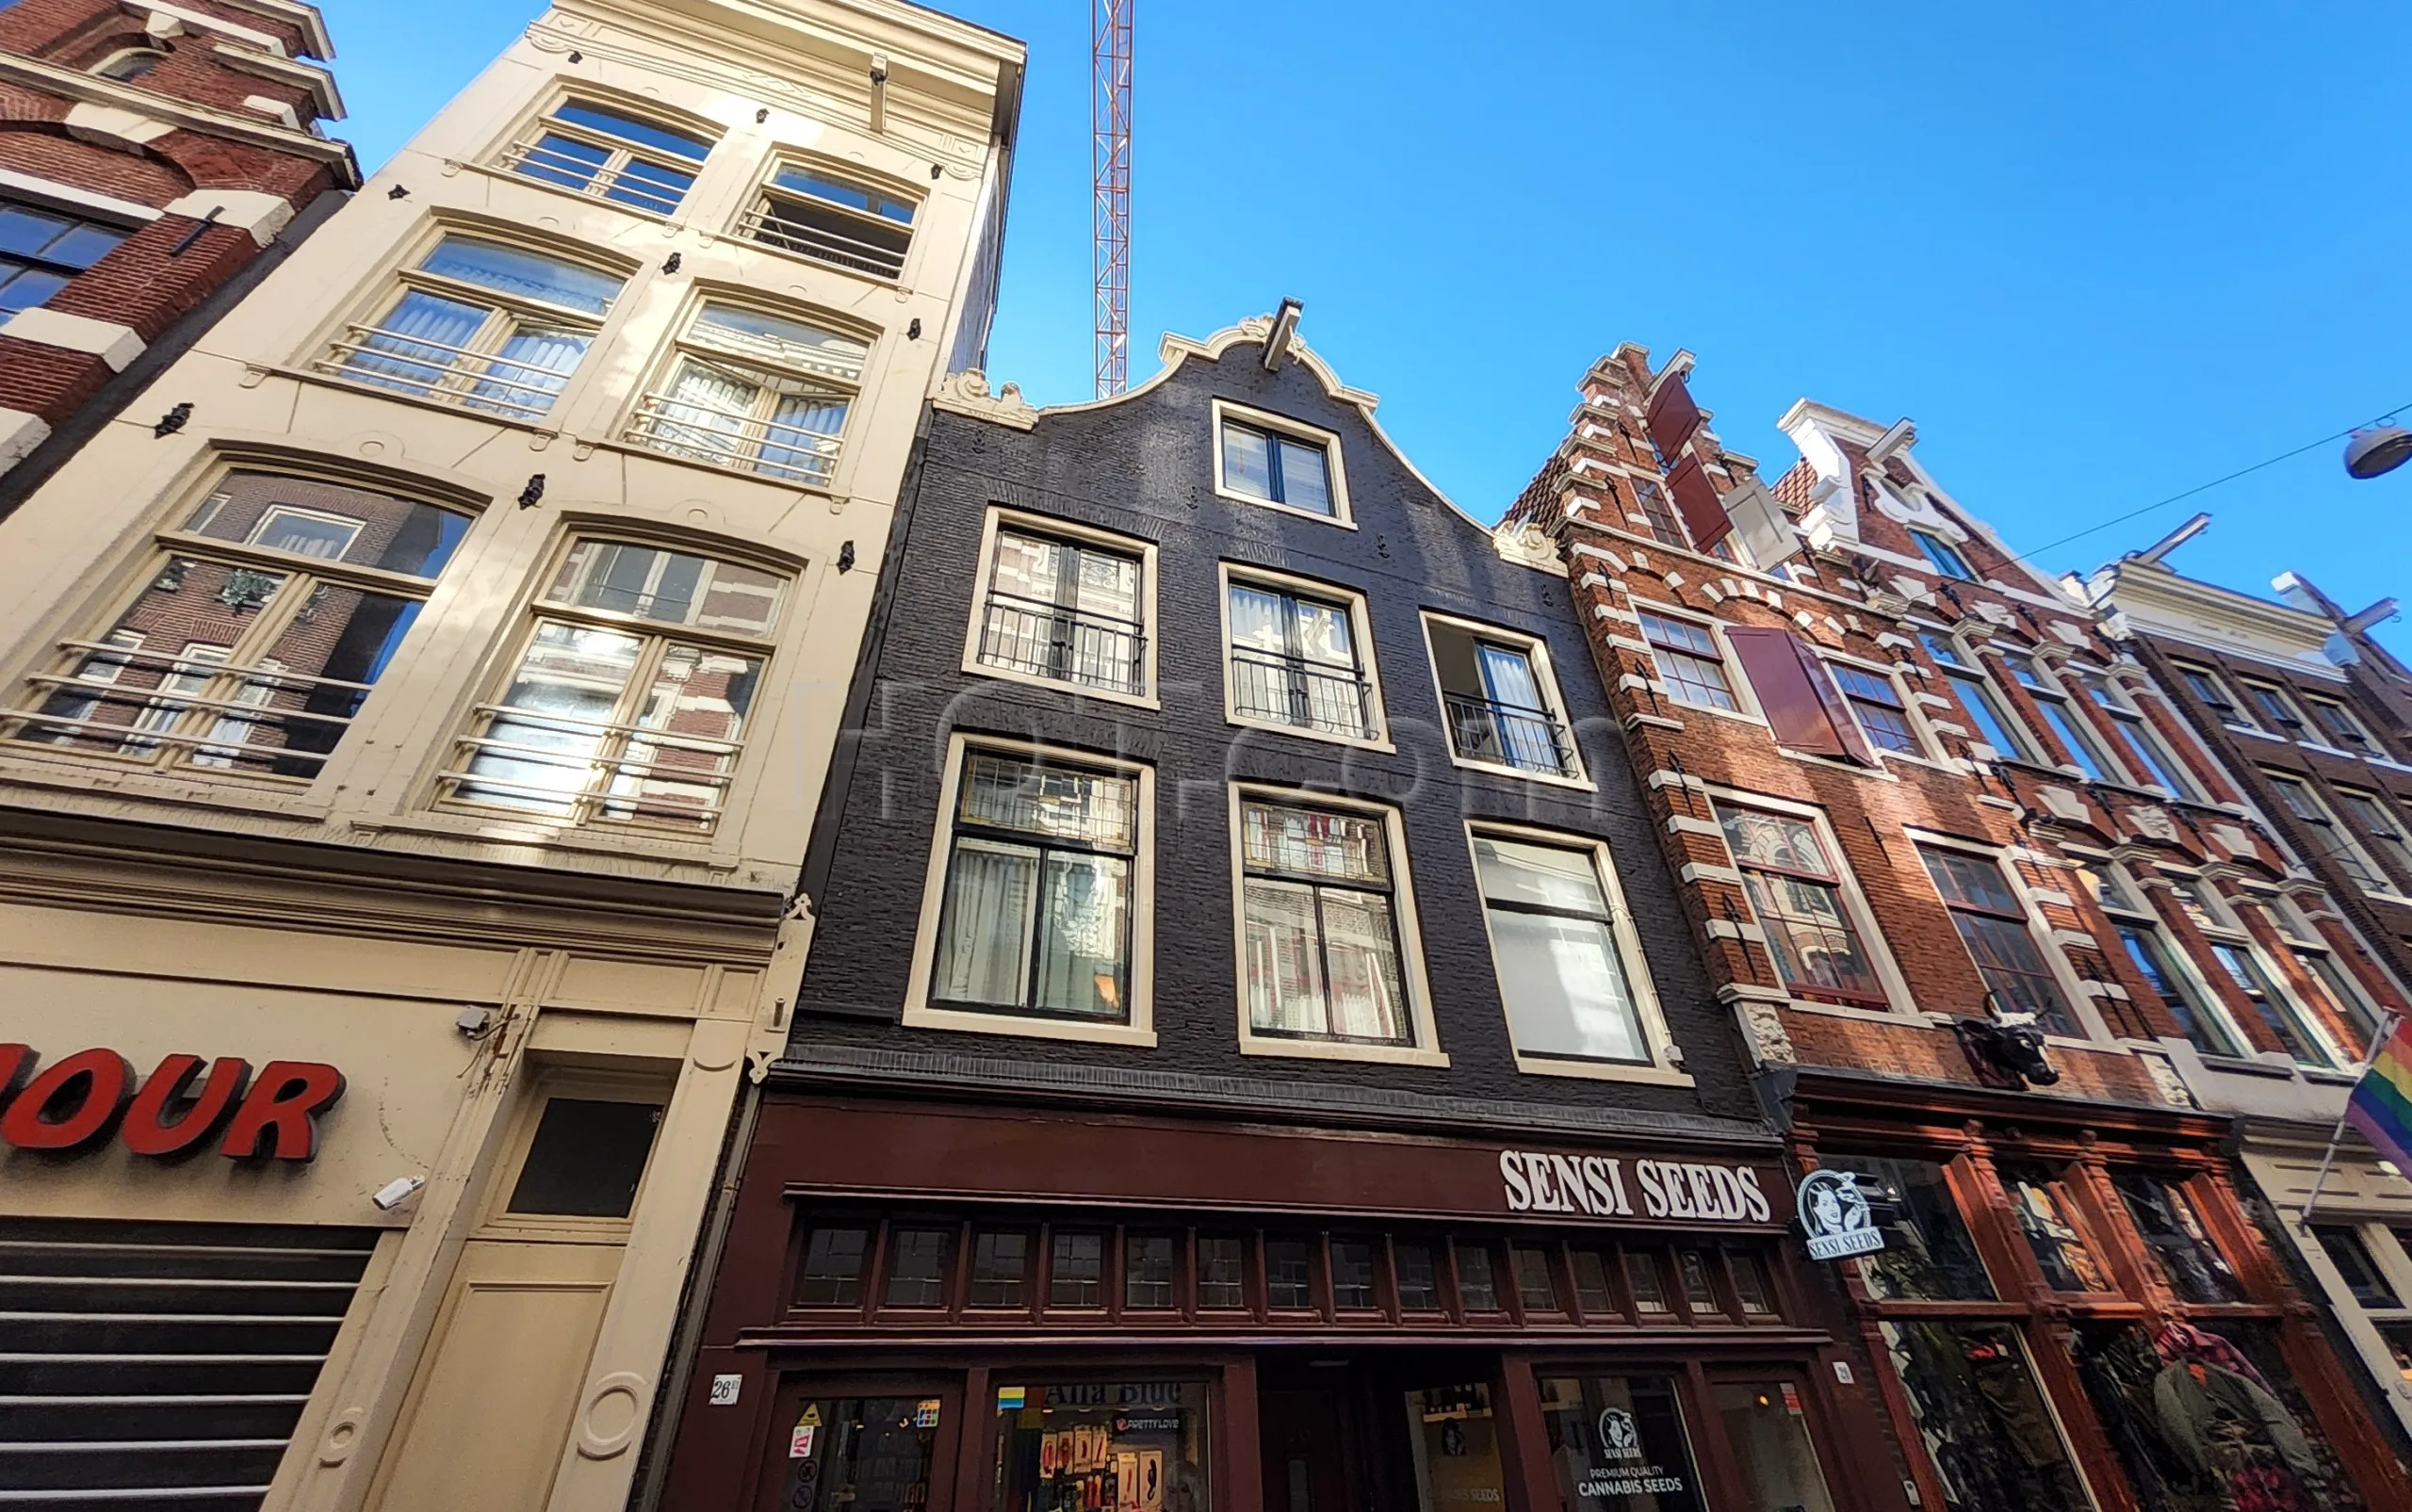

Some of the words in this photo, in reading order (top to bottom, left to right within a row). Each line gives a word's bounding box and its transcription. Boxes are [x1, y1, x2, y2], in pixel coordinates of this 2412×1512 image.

[1500, 1150, 1634, 1216] SENSI
[1637, 1160, 1770, 1222] SEEDS
[1809, 1238, 1842, 1259] SENSI
[1842, 1230, 1882, 1252] SEEDS
[1589, 1467, 1630, 1480] PREMIUM
[1630, 1466, 1664, 1478] QUALITY
[1578, 1479, 1643, 1497] CANNABIS
[1643, 1477, 1684, 1493] SEEDS
